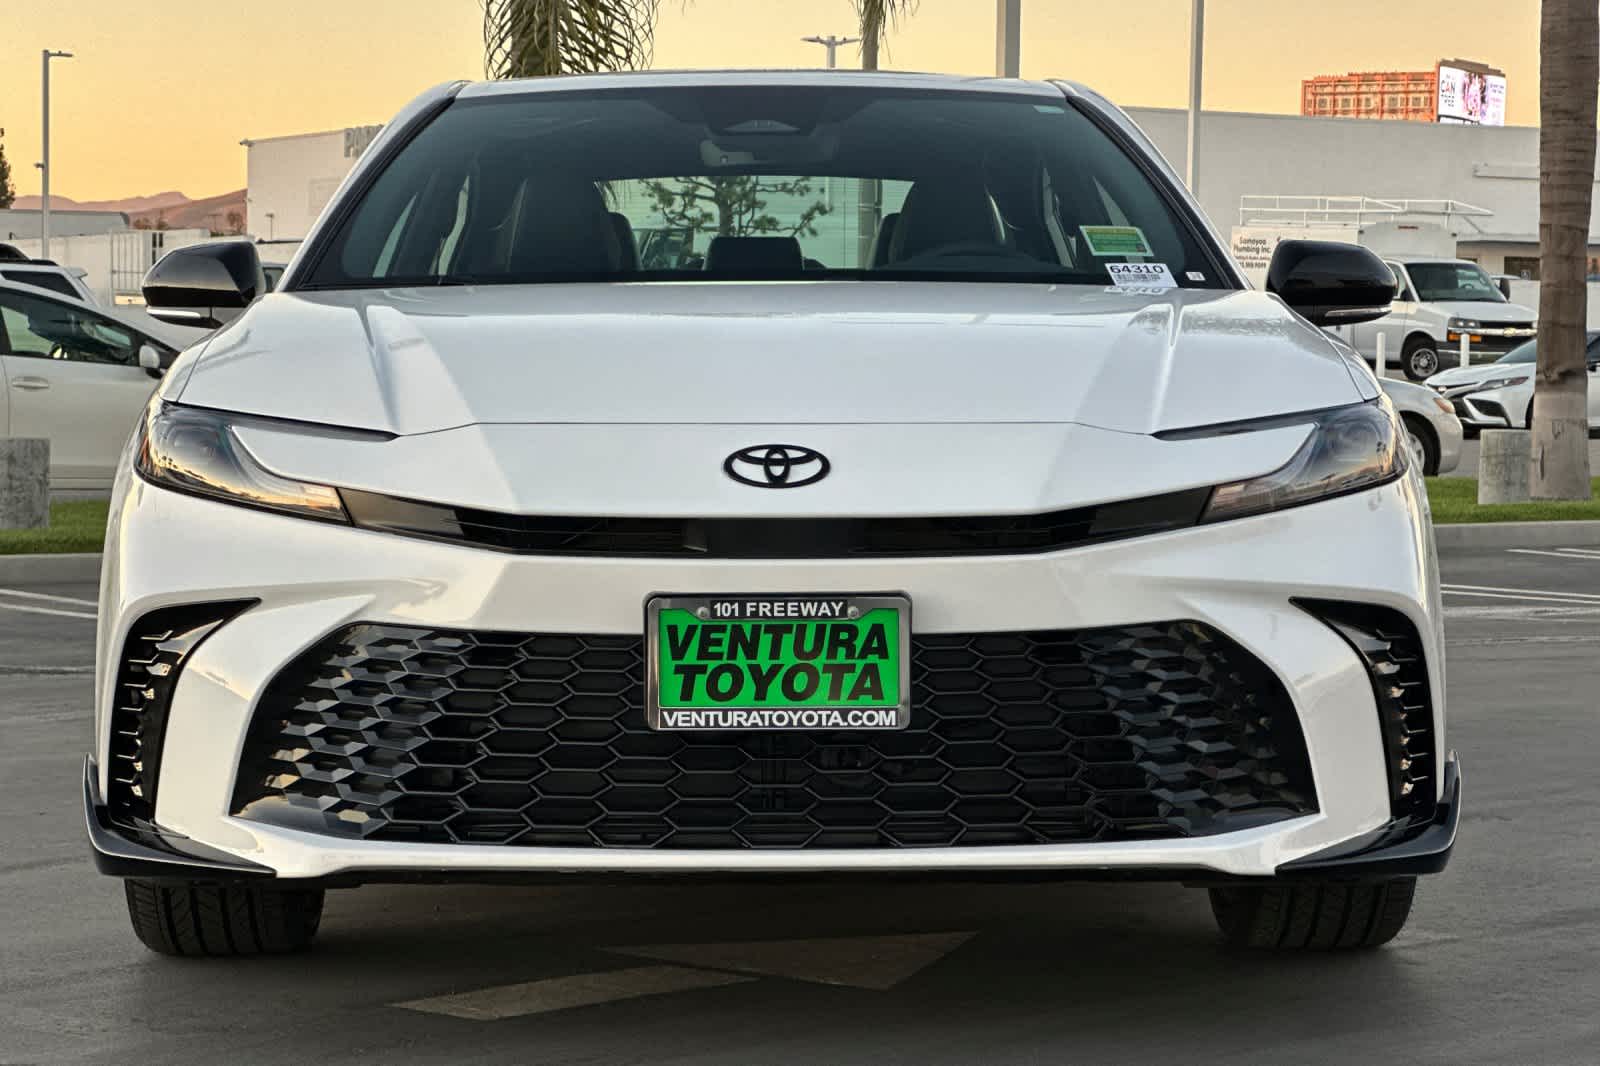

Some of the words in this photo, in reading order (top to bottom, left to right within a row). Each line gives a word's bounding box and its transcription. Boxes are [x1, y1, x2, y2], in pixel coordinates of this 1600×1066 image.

[1109, 264, 1165, 274] 64310
[713, 602, 740, 617] 101
[746, 602, 844, 617] FREEWAY
[666, 623, 889, 661] VENTURA
[673, 663, 885, 702] TOYOTA
[663, 710, 897, 728] VENTURATOYOTA.COM
